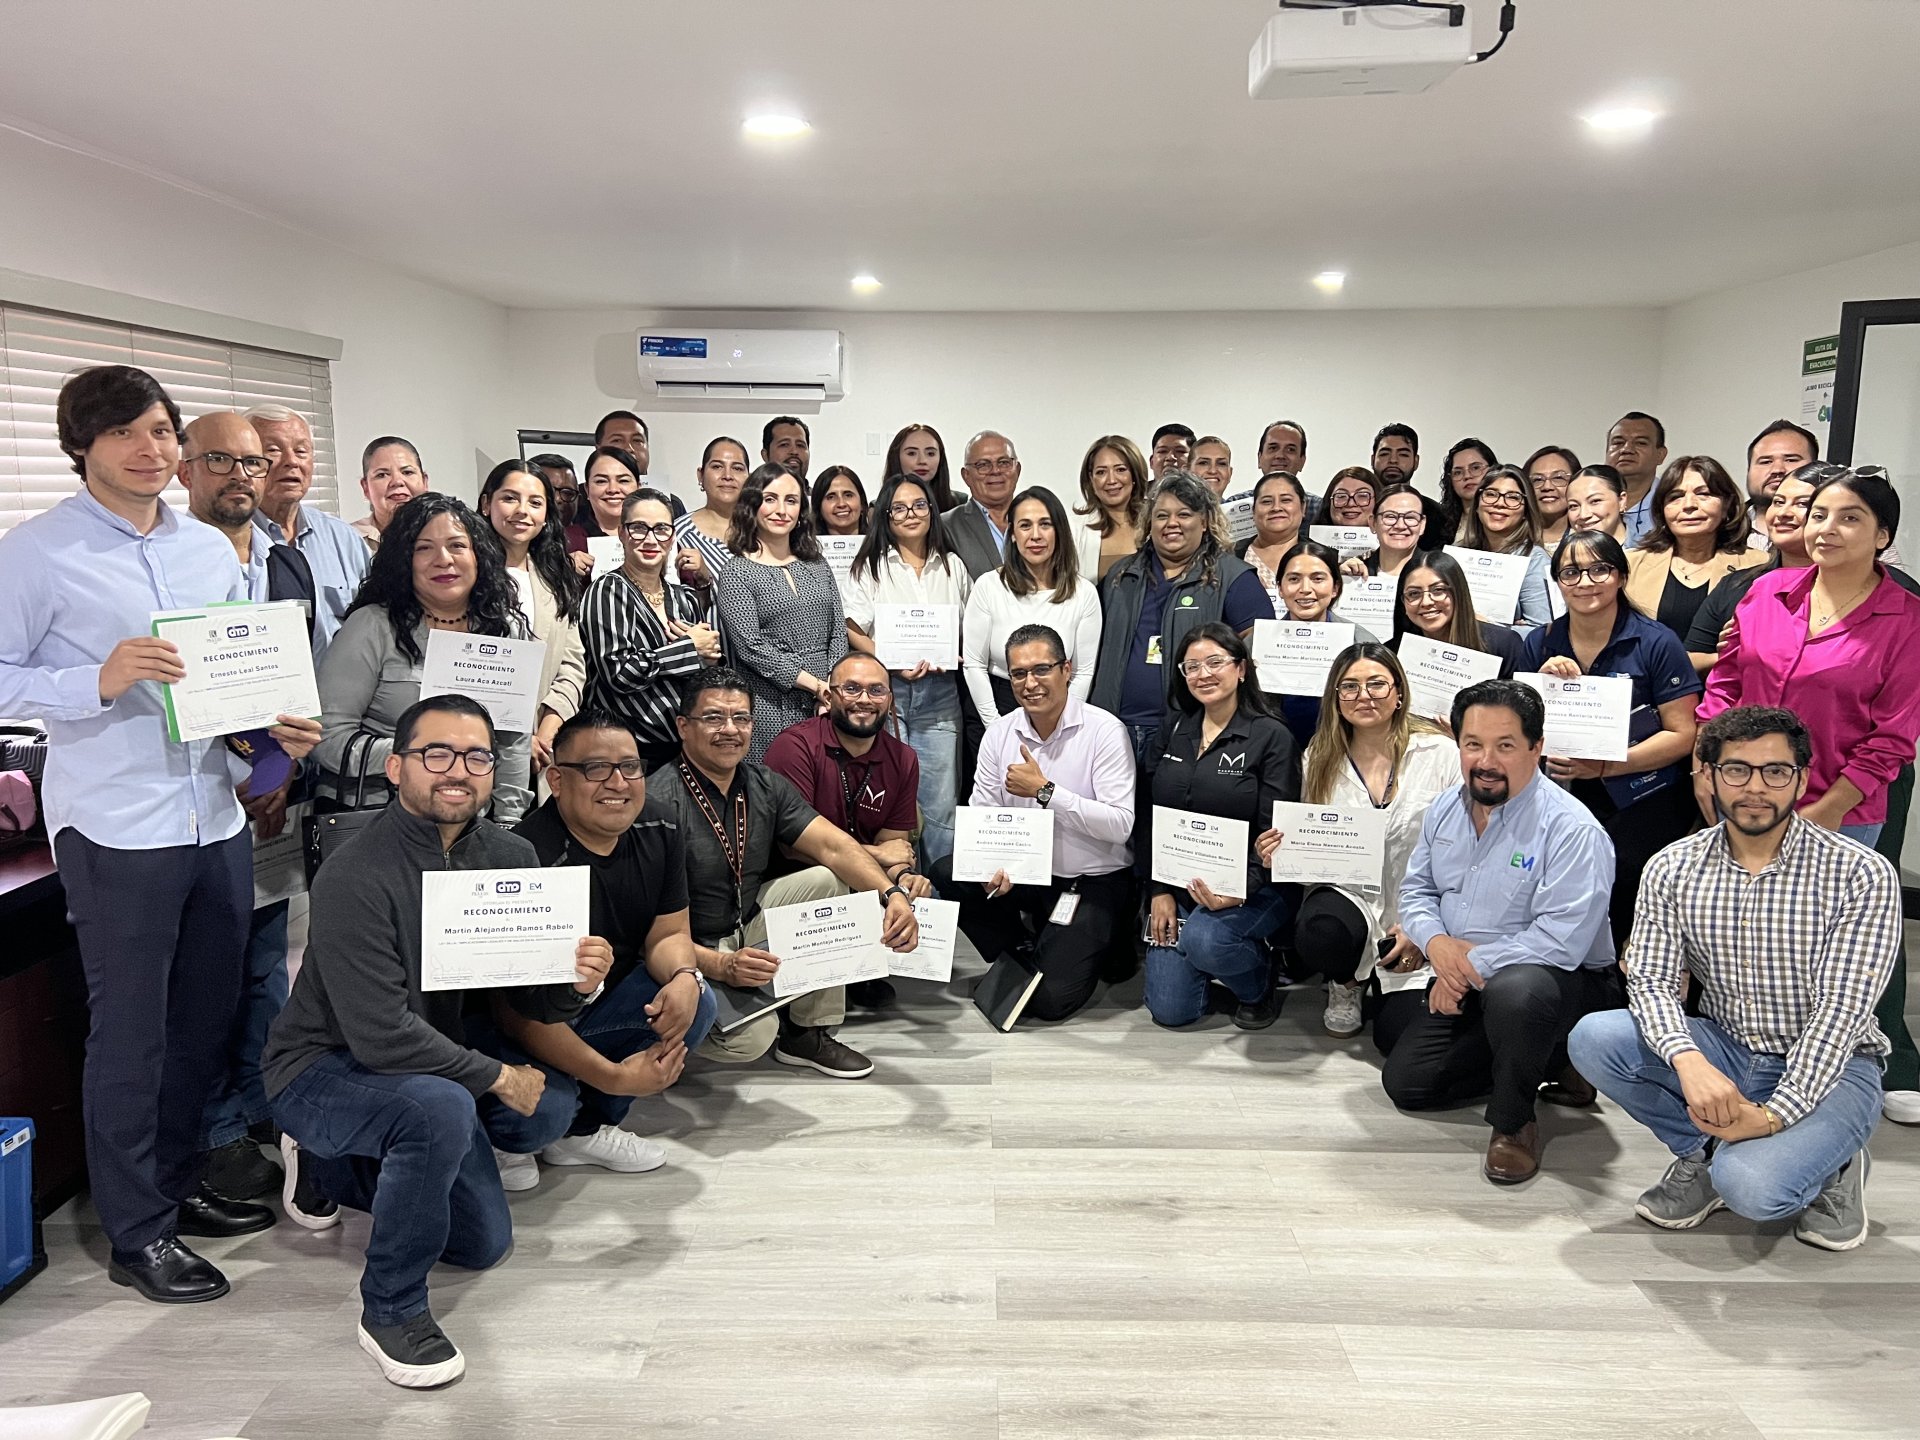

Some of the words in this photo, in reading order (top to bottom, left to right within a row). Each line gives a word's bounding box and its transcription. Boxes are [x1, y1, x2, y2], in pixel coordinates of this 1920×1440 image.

[203, 646, 279, 663] RECONOCIMIENTO
[210, 670, 237, 679] Ernesto
[256, 664, 279, 672] Santos
[454, 662, 515, 673] RECONOCIMIENTO
[1420, 662, 1471, 680] RECONOCIMIENTO
[1299, 829, 1358, 837] RECONOCIMIENTO
[1173, 834, 1224, 847] RECONOCIMIENTO
[464, 906, 552, 916] RECONOCIMIENTO
[474, 926, 514, 934] Alejandro
[796, 922, 856, 937] RECONOCIMIENTO
